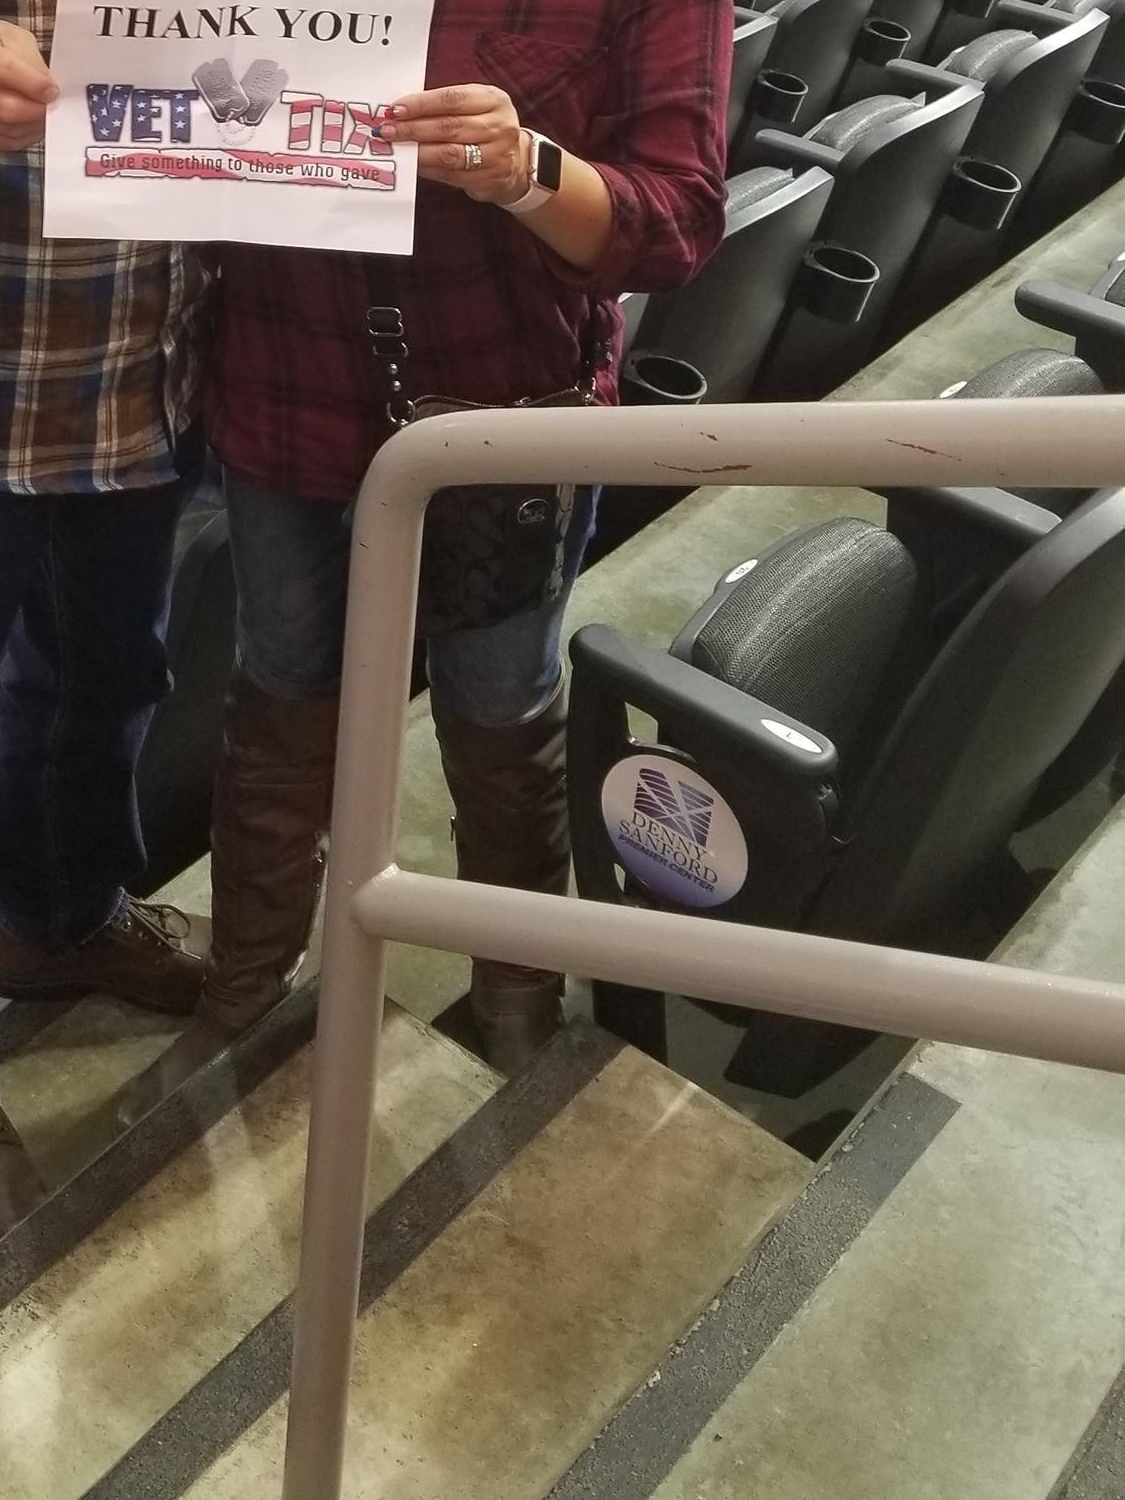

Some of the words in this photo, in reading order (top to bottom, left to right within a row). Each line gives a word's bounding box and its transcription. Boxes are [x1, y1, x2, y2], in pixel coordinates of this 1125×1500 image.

[93, 4, 260, 39] THANK
[274, 7, 393, 47] YOU!
[85, 83, 200, 143] VET
[280, 90, 396, 156] TIX
[100, 153, 140, 171] Give
[141, 154, 223, 173] something
[227, 155, 243, 172] to
[248, 157, 295, 176] those
[299, 161, 335, 179] who
[341, 166, 381, 183] gave
[618, 819, 719, 886] SANFORD
[630, 811, 707, 861] DENNY
[618, 835, 671, 868] PREMIER
[667, 861, 717, 893] CENTER
